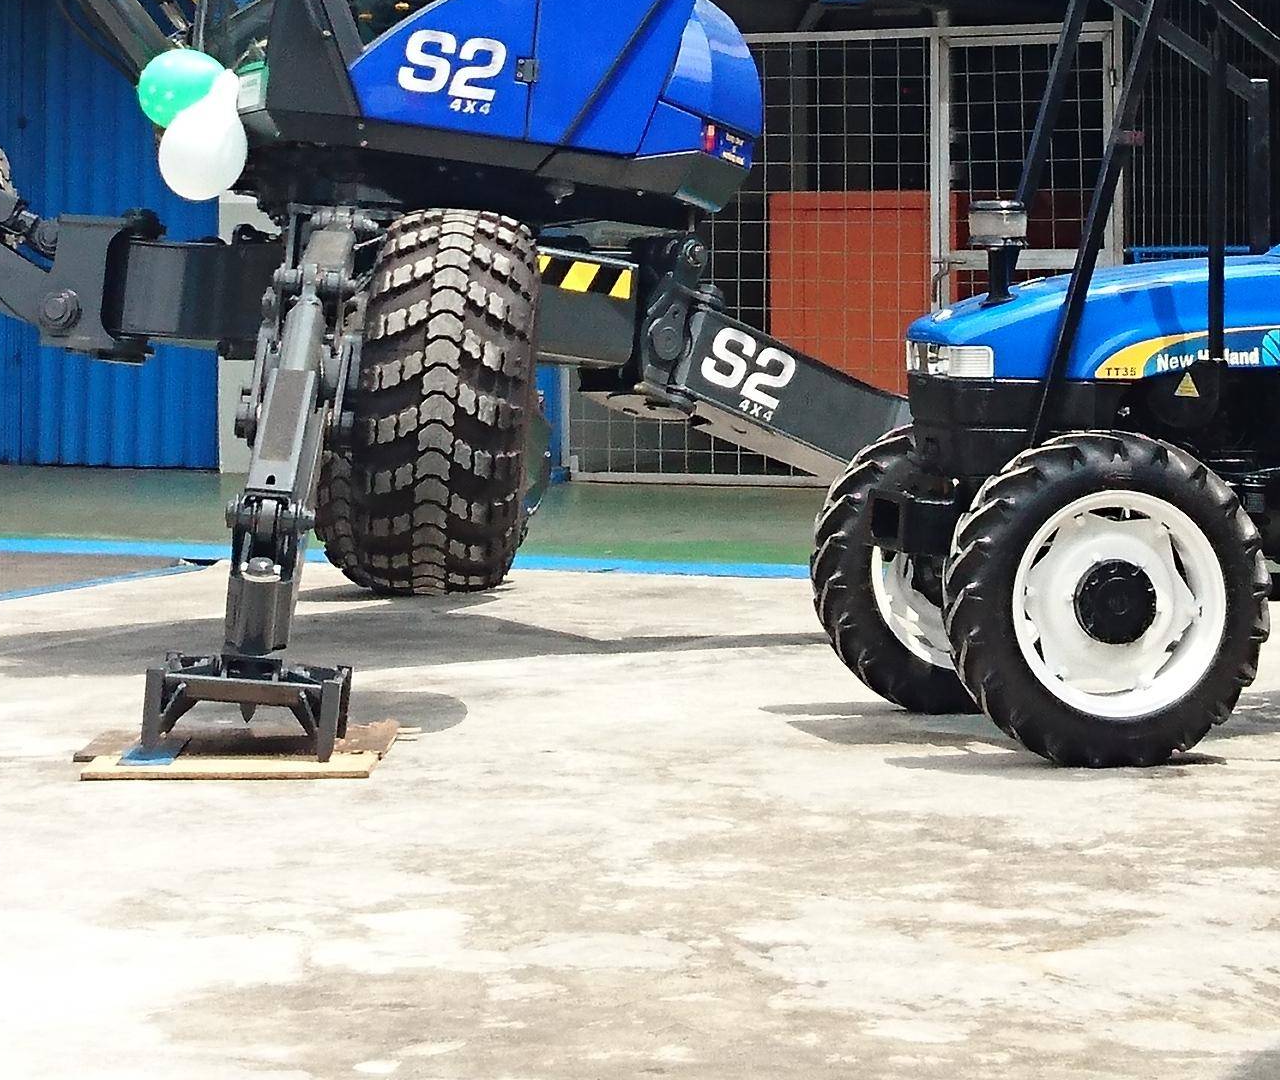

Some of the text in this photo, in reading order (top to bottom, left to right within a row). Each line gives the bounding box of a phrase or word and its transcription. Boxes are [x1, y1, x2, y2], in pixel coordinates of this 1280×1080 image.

[398, 29, 507, 101] S2
[700, 326, 796, 410] S2
[1105, 367, 1137, 377] TT35
[1157, 354, 1194, 371] New
